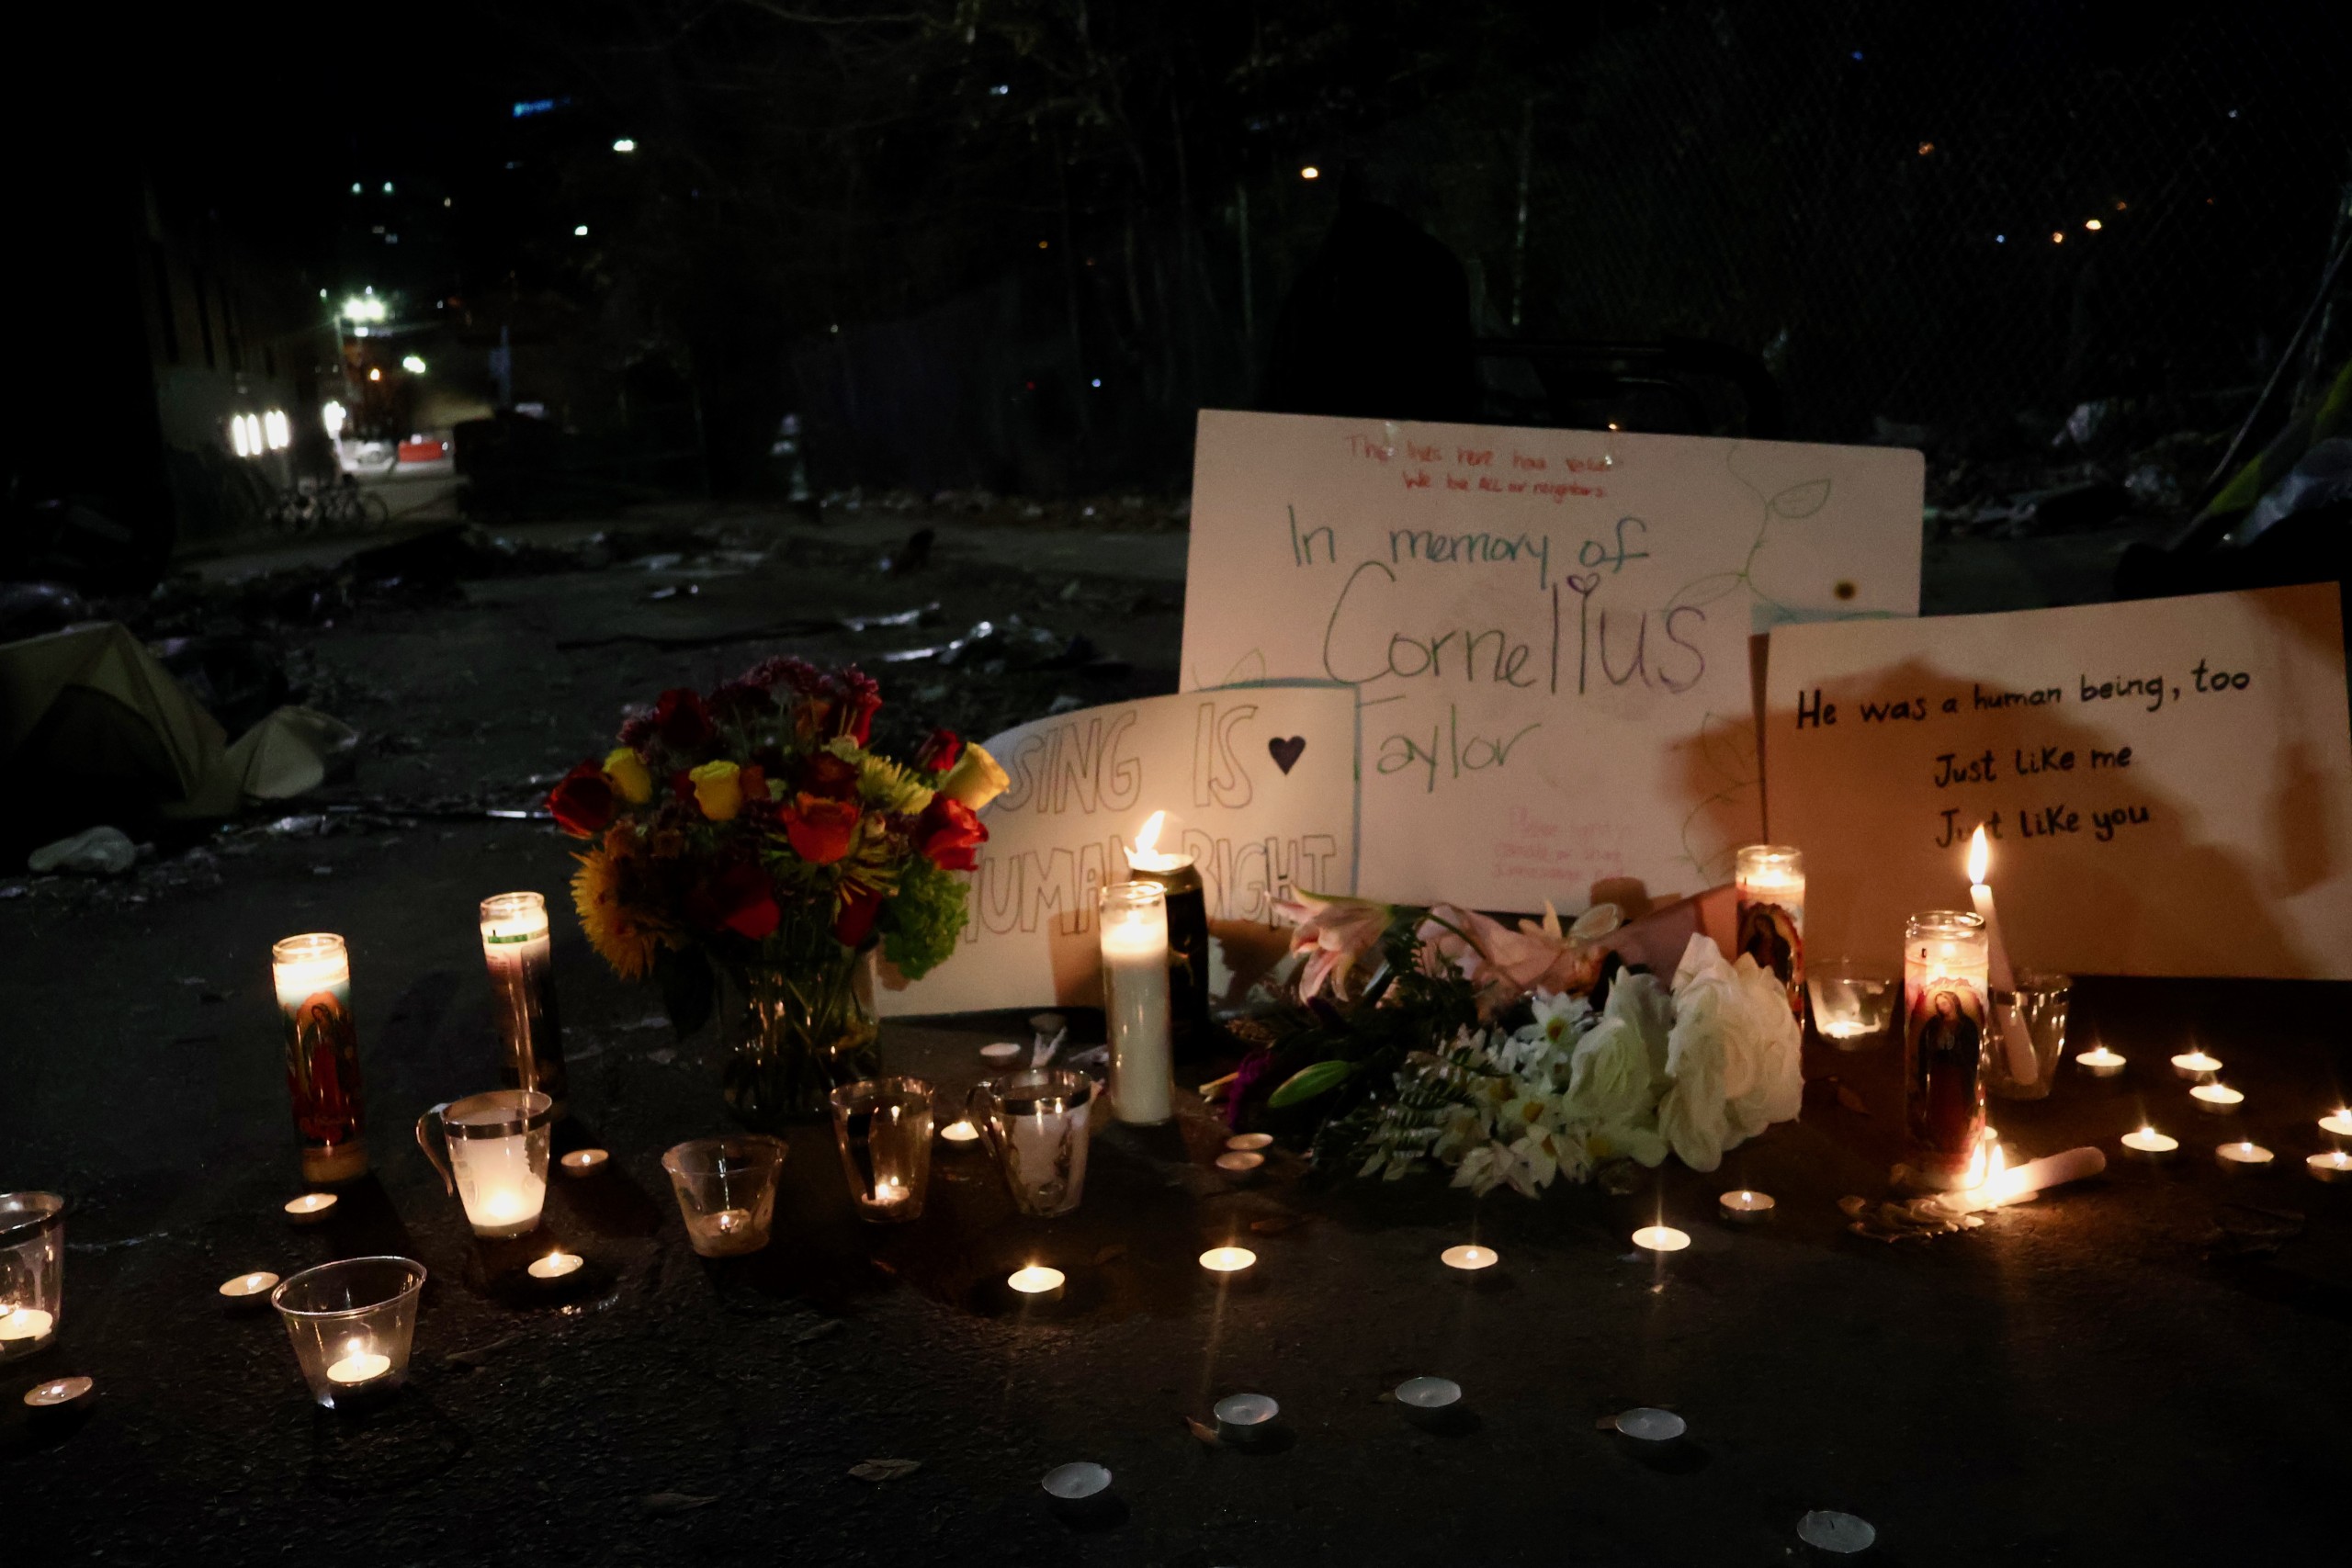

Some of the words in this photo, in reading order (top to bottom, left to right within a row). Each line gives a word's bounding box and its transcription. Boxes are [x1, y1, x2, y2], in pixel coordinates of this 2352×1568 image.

[1288, 505, 1335, 568] In
[1389, 528, 1549, 590] memory
[1577, 516, 1650, 574] of
[1323, 560, 1707, 694] Cornelius
[1796, 690, 1837, 728] He
[1860, 695, 1926, 723] was
[1940, 698, 1959, 715] a
[1973, 683, 2062, 711] human
[2080, 673, 2180, 712] being,
[2192, 660, 2251, 691] too
[993, 710, 1143, 815] SING
[1195, 702, 1259, 809] IS
[1935, 750, 1997, 788] Just
[2090, 745, 2133, 769] me
[2091, 806, 2150, 841] you
